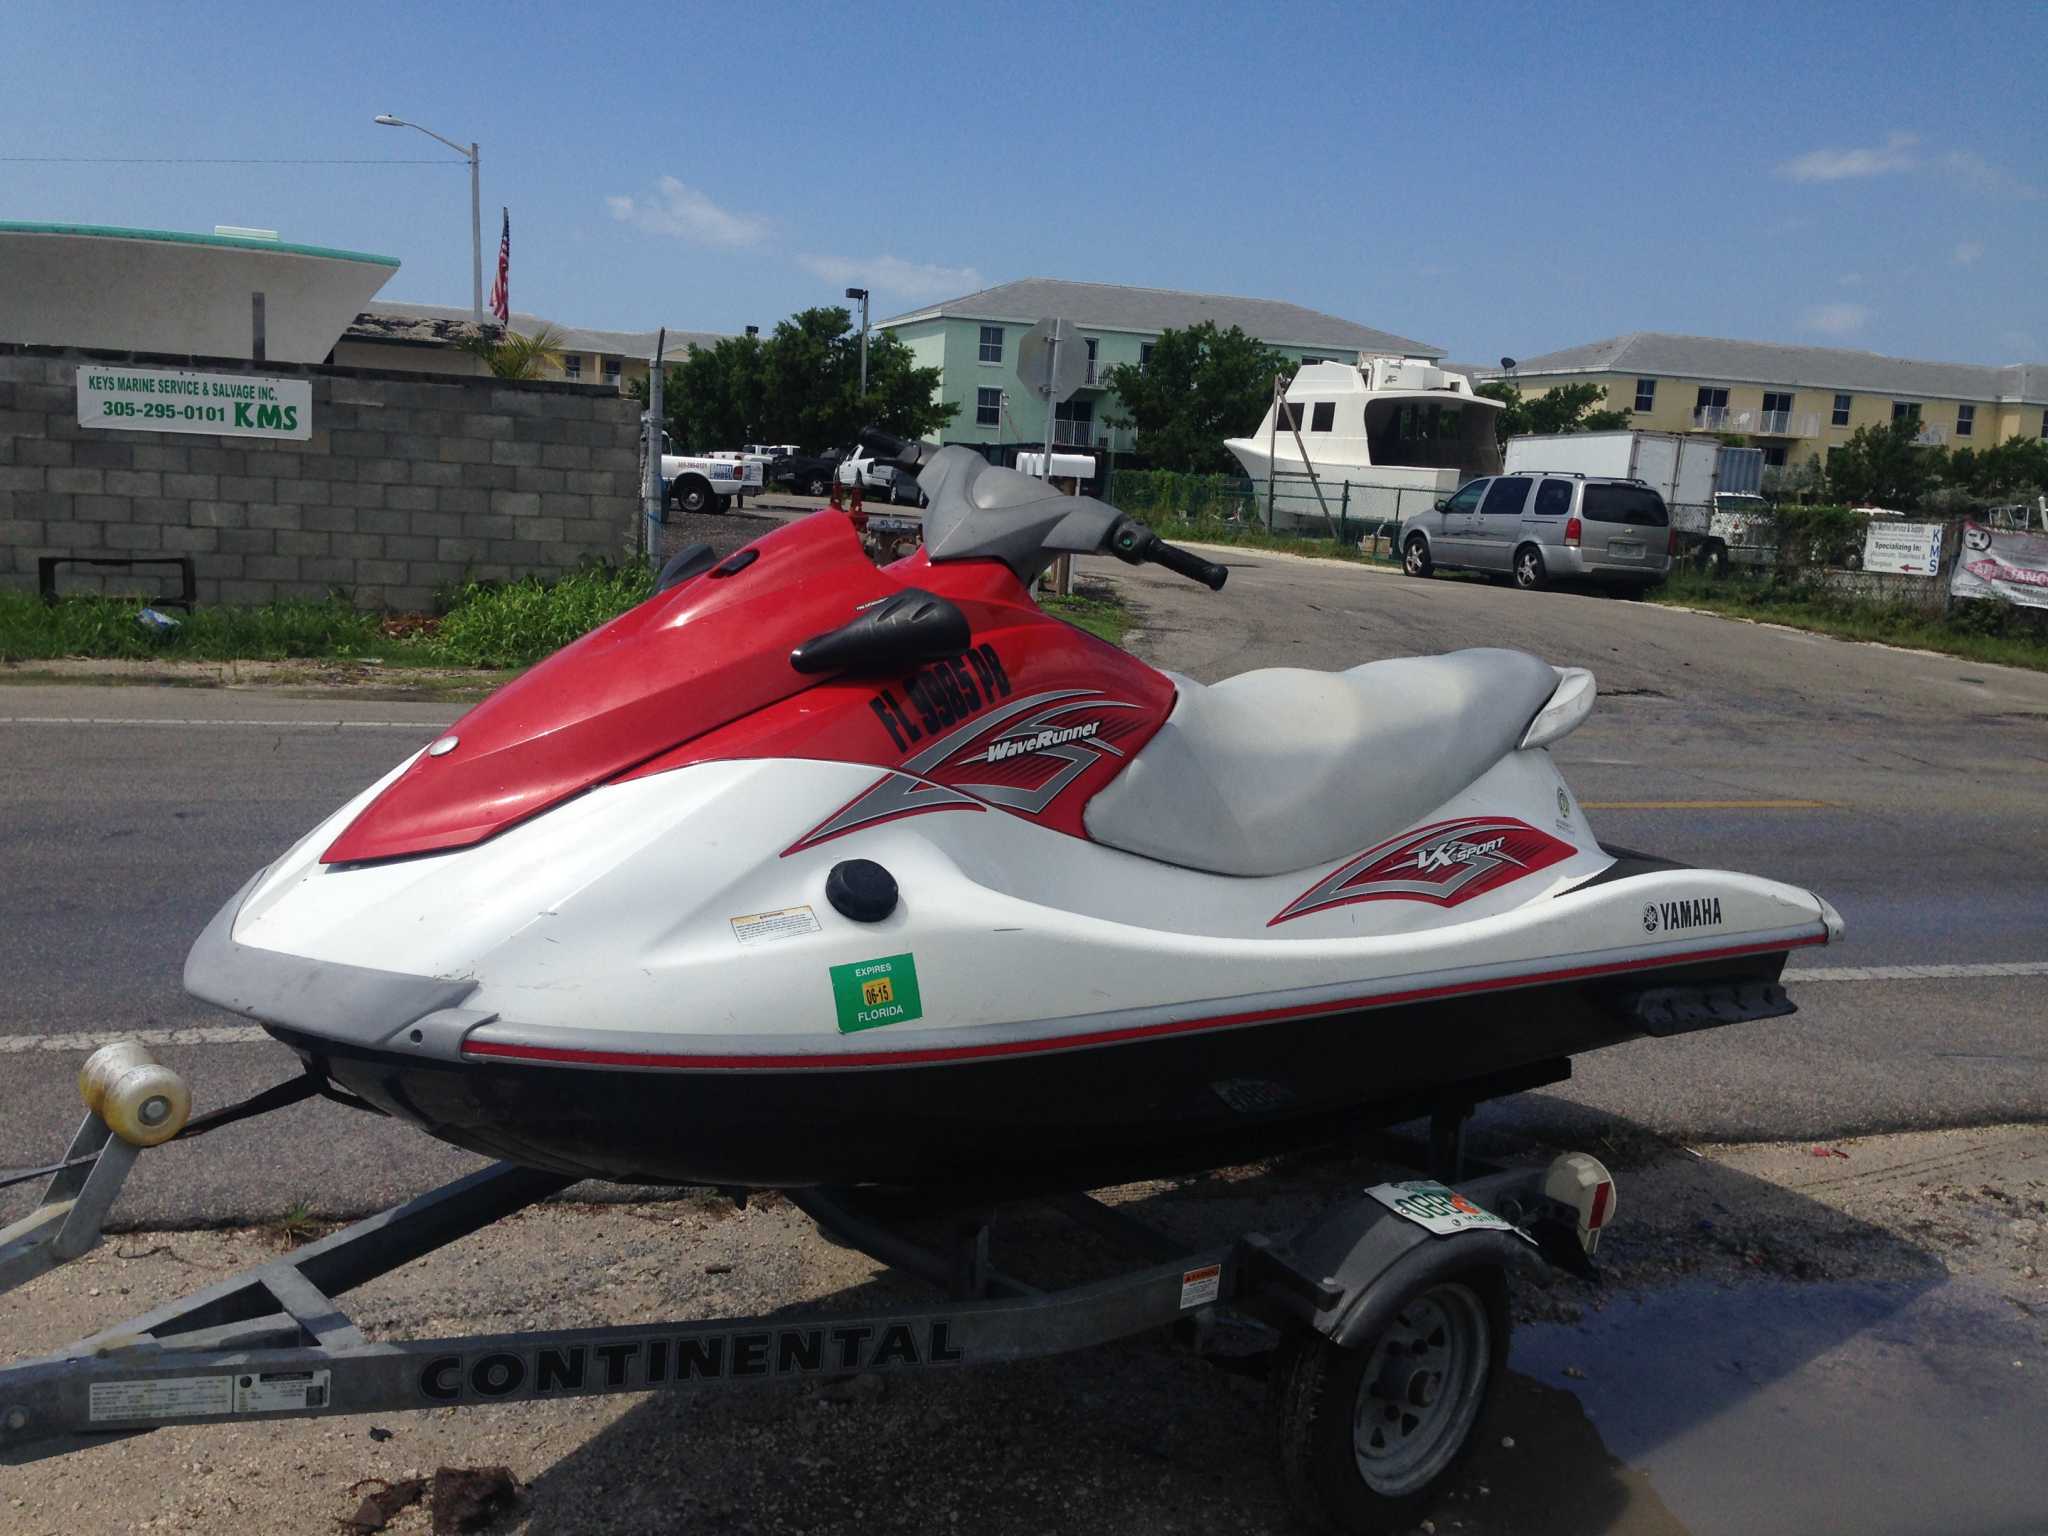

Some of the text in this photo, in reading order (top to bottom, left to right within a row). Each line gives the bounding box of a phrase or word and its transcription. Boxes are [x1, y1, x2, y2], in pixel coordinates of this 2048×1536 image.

[89, 375, 278, 401] KEYS MARINE SERVICE & SALVAGE INC.
[103, 400, 225, 422] 305-295-0101
[234, 401, 298, 431] KMS
[1875, 541, 1911, 552] Specializing
[869, 688, 921, 752] FL
[986, 721, 1101, 762] WaveRunner
[1417, 836, 1505, 873] VX SPORT
[1660, 897, 1722, 930] YAMAHA
[855, 963, 892, 977] EXPIRES
[865, 985, 889, 1005] 06-15
[857, 1005, 904, 1022] FLORIDA
[417, 1319, 963, 1400] CONTINENTAL
